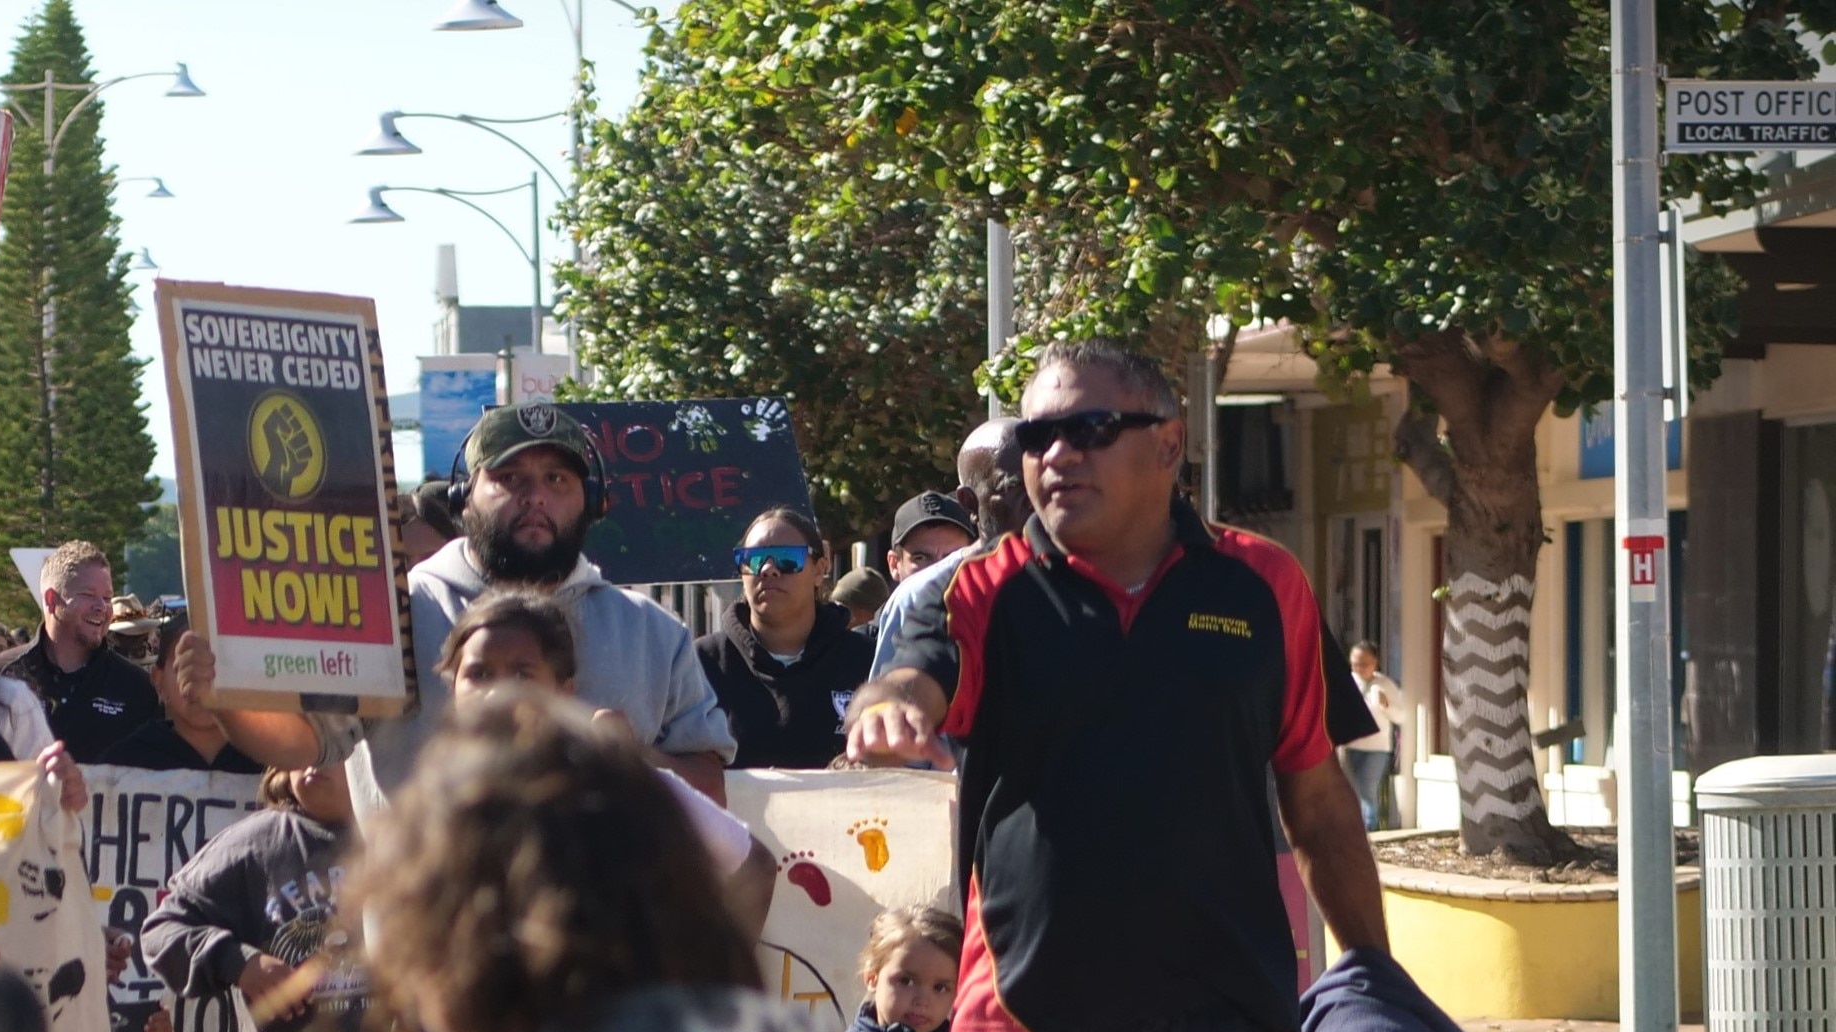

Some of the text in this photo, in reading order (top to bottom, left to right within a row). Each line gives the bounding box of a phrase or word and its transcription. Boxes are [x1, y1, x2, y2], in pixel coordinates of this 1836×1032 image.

[1677, 91, 1836, 116] POST OFFIC
[1684, 125, 1830, 141] LOCAL TRAFFIC
[185, 313, 356, 358] SOVEREIGNTY
[192, 347, 361, 391] NEVER CEDED
[216, 506, 379, 568] JUSTICE
[1633, 553, 1653, 582] H
[241, 568, 363, 627] NOW!
[264, 653, 318, 678] green
[320, 649, 352, 677] left
